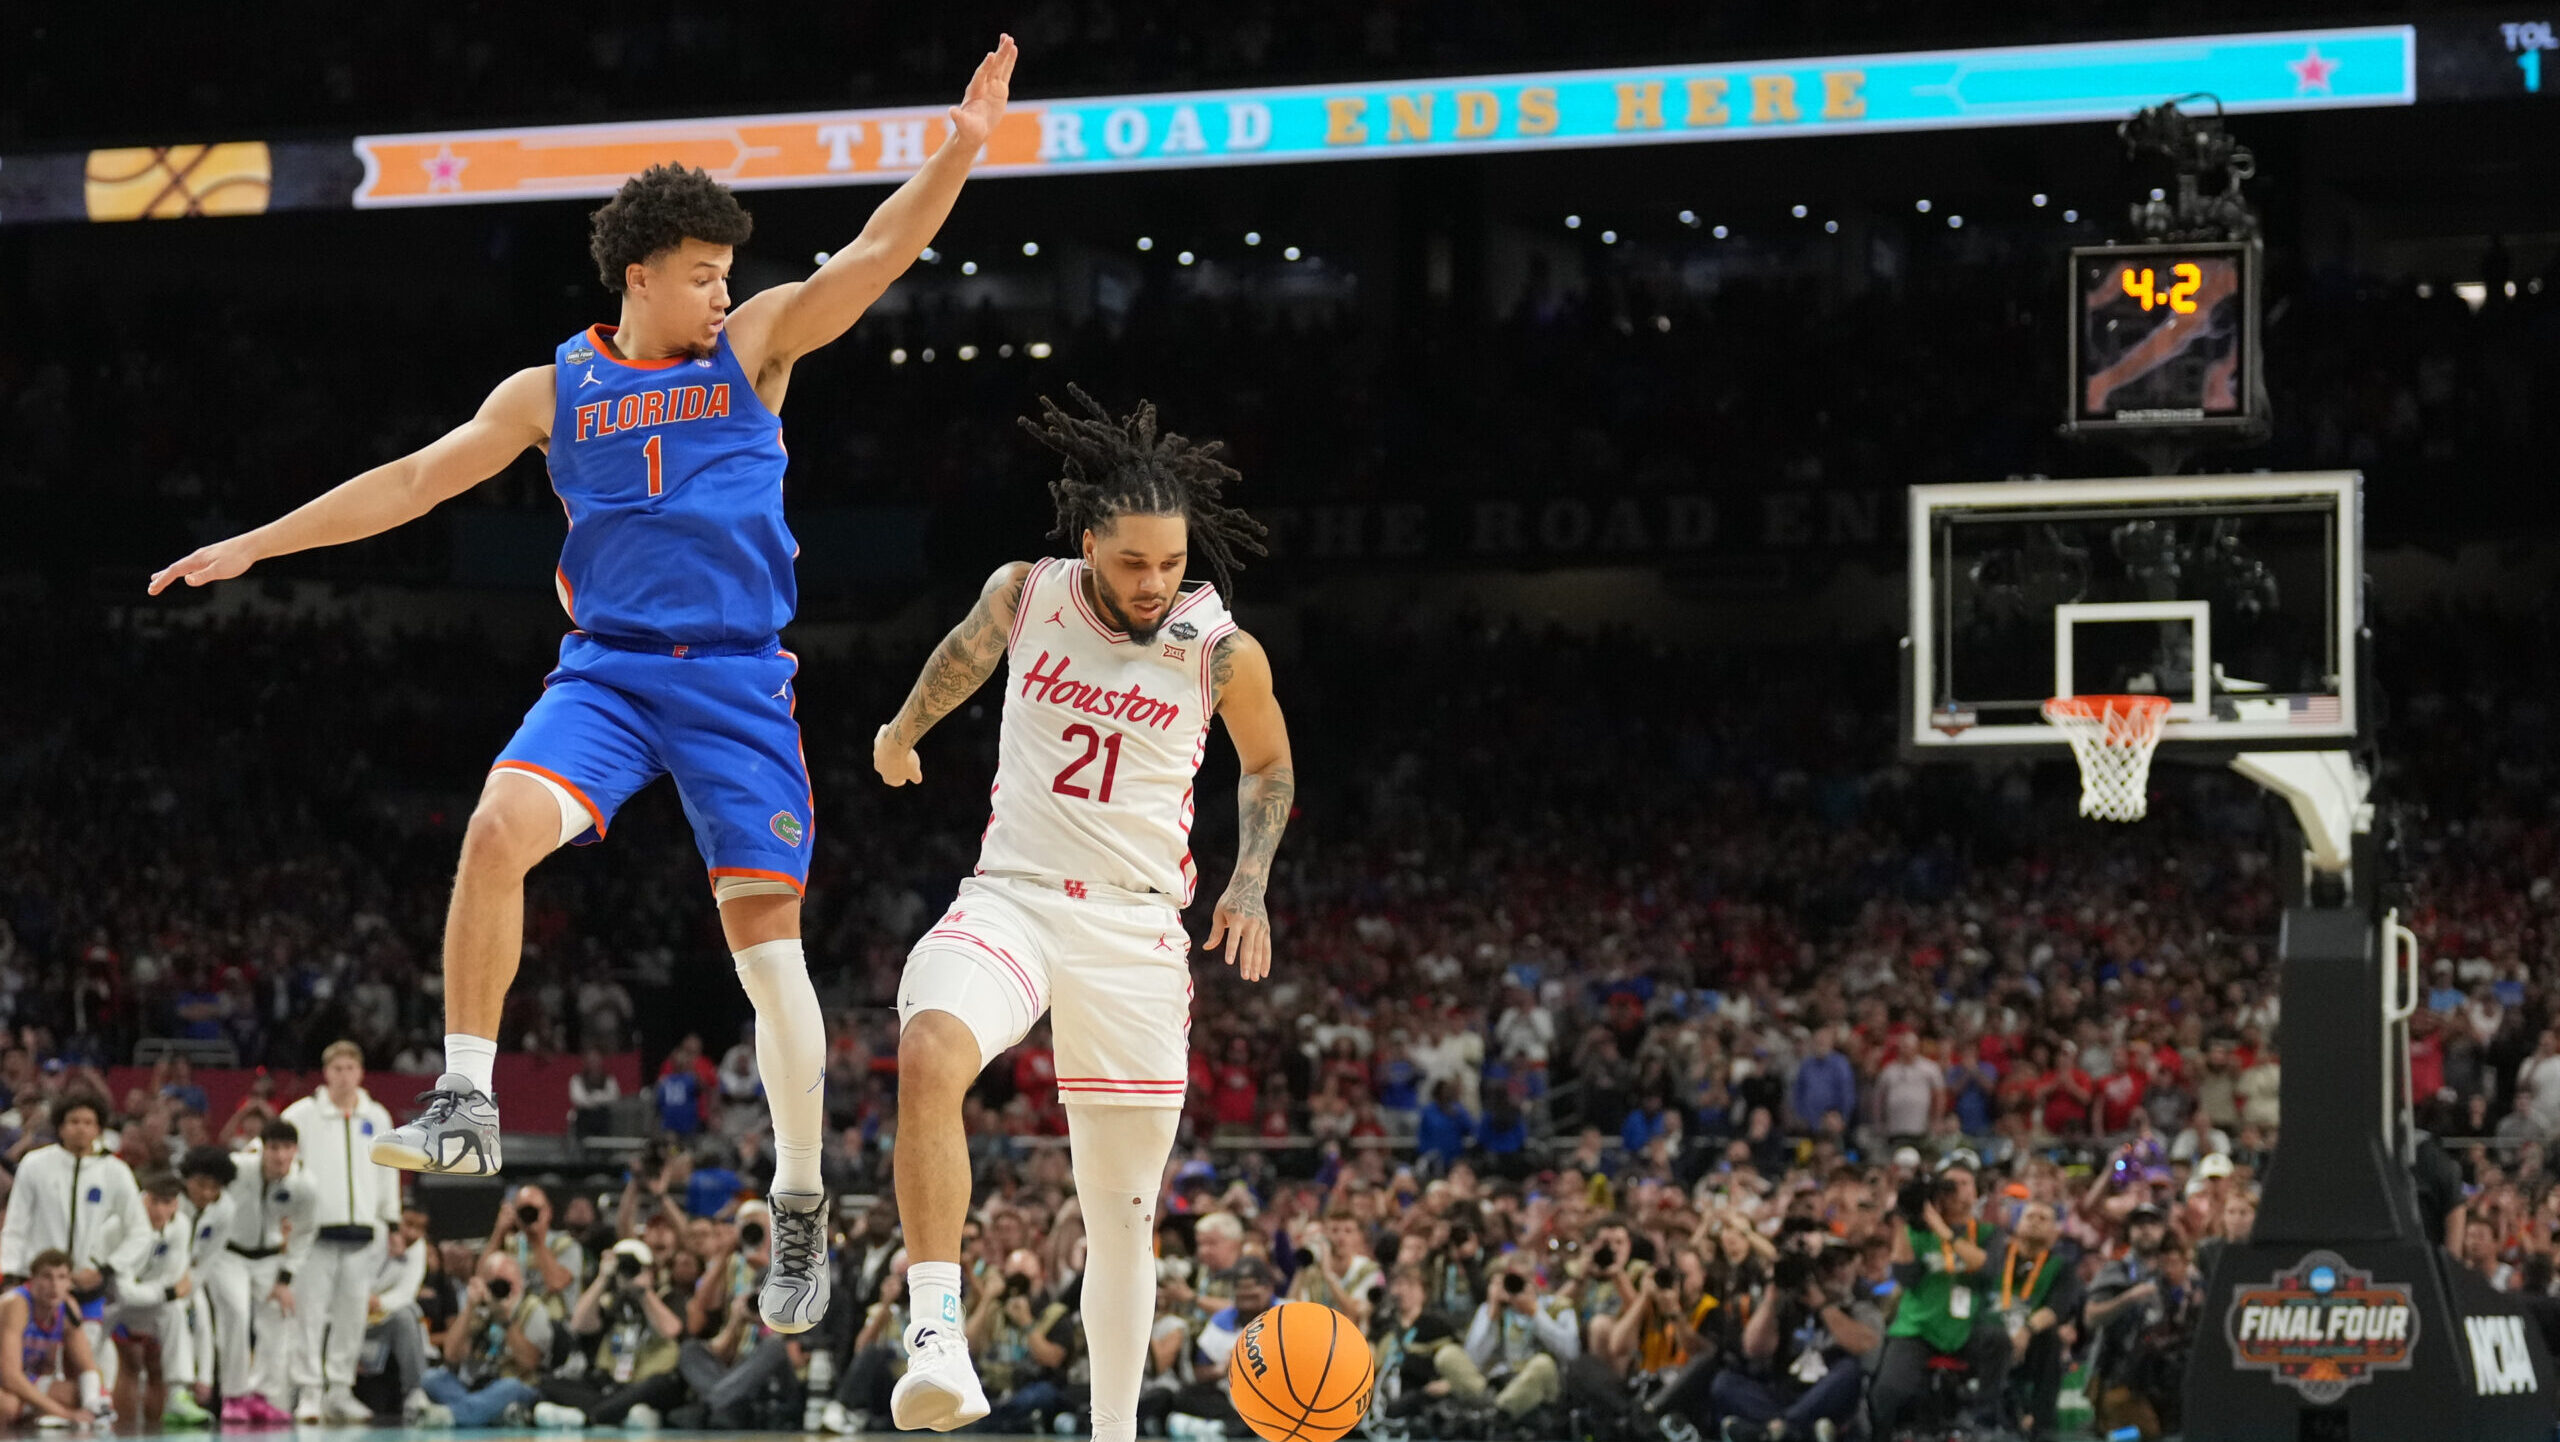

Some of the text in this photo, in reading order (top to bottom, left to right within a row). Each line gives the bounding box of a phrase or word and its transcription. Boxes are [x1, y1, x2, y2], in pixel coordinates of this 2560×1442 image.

[2499, 21, 2559, 52] TOL
[2517, 48, 2541, 93] 1
[1037, 102, 1272, 162] ROAD
[1324, 87, 1559, 145] ENDS
[1613, 70, 1867, 131] HERE
[2121, 262, 2202, 314] 4.2
[575, 383, 730, 442] FLORIDA
[643, 435, 663, 497] 1
[1271, 489, 1906, 557] THE ROAD EN
[1021, 650, 1180, 732] Houston
[1052, 723, 1122, 803] 21
[2239, 1305, 2410, 1341] FINAL FOUR
[2463, 1315, 2538, 1397] NCAA
